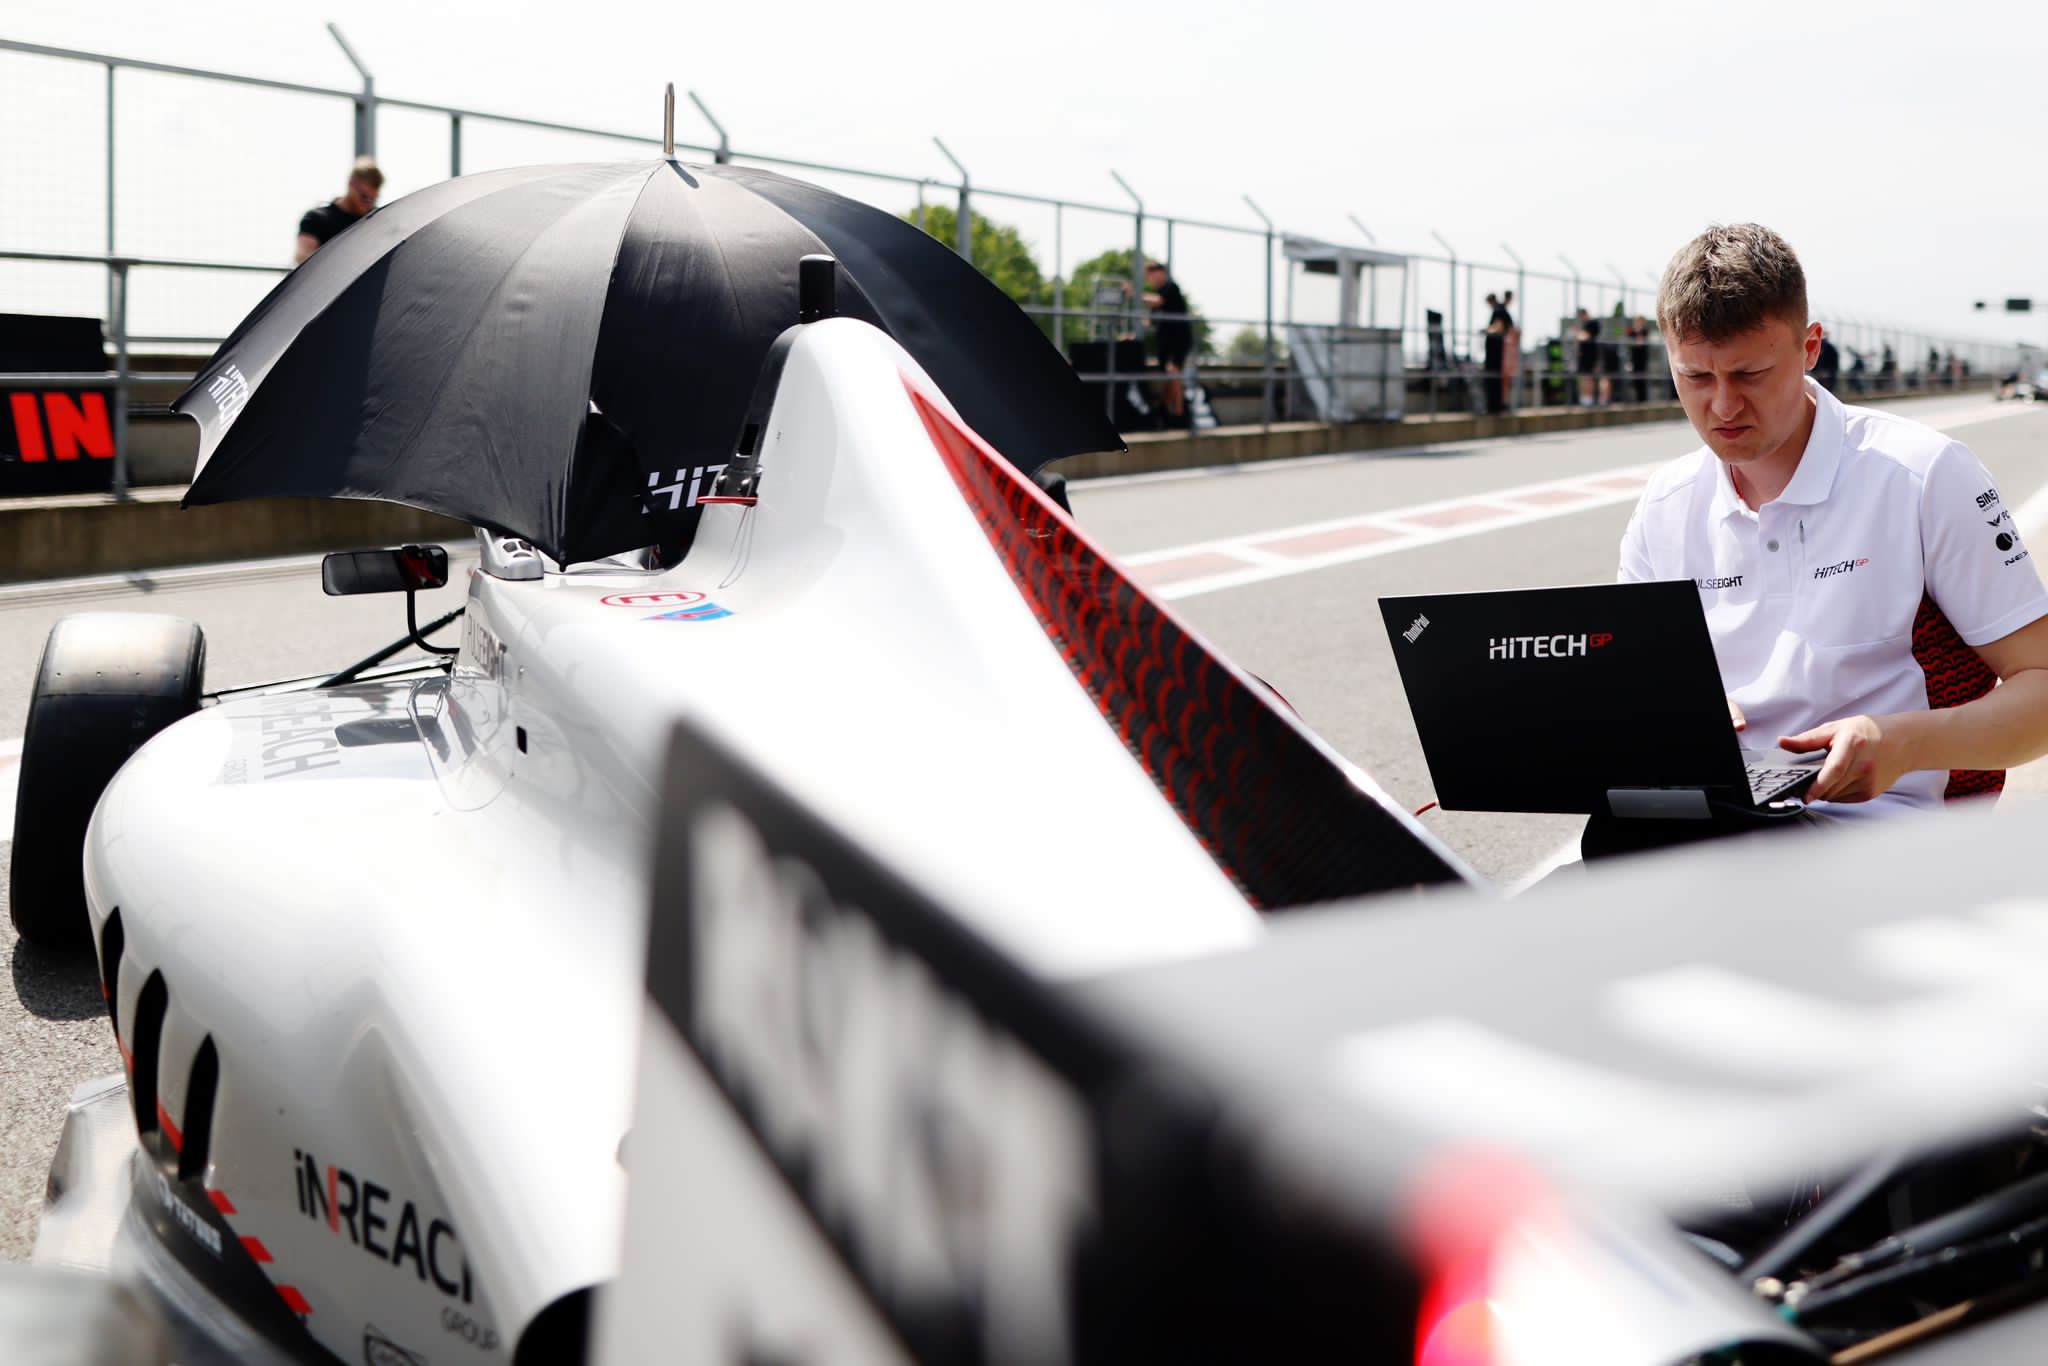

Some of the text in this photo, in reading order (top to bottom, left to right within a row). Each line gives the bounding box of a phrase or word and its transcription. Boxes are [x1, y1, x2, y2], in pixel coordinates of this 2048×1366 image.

[10, 391, 117, 462] IN
[1814, 559, 1855, 579] HITECH
[1489, 633, 1613, 660] HITECH GP
